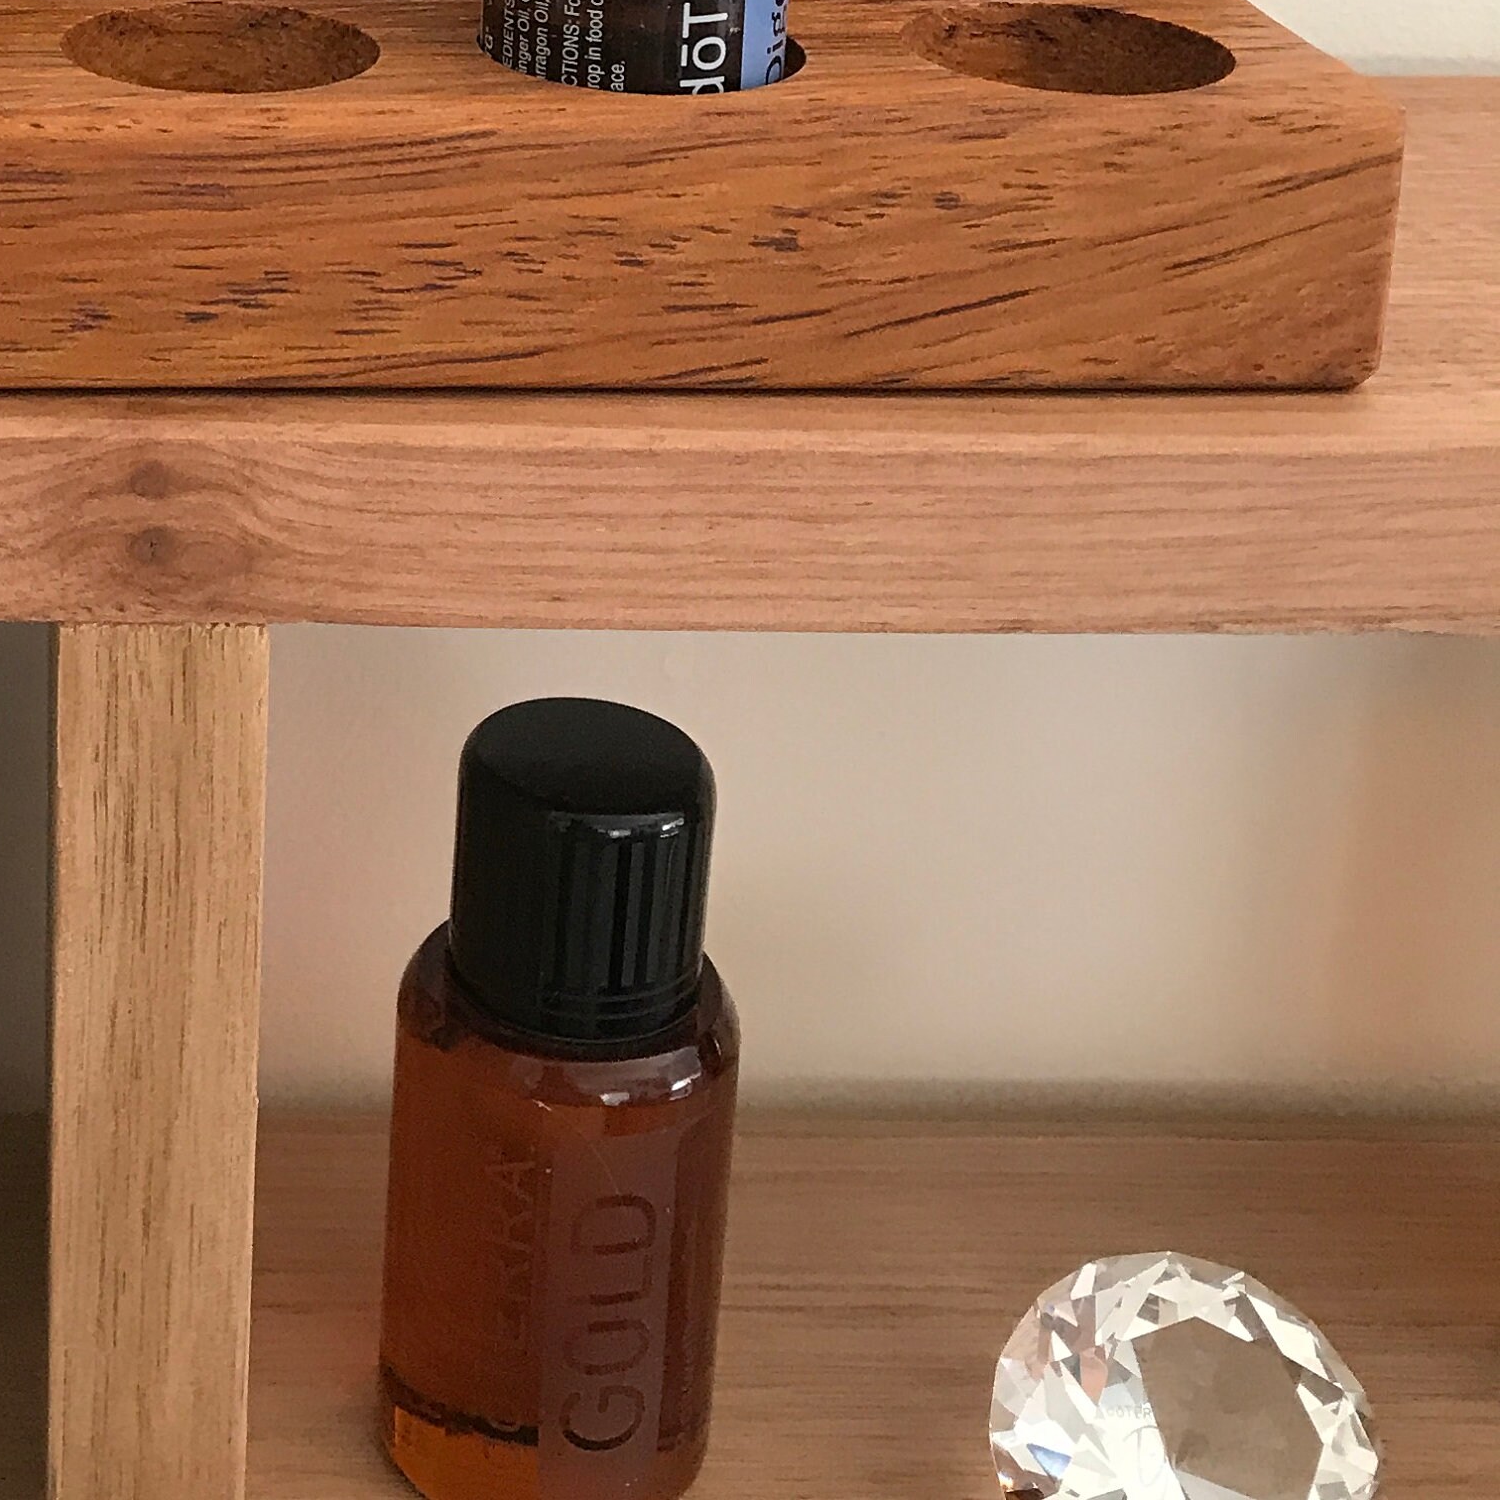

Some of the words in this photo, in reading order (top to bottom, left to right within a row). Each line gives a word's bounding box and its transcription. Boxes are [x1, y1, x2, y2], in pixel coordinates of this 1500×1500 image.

[534, 0, 552, 24] Oil,
[584, 9, 604, 43] food
[583, 46, 603, 61] in
